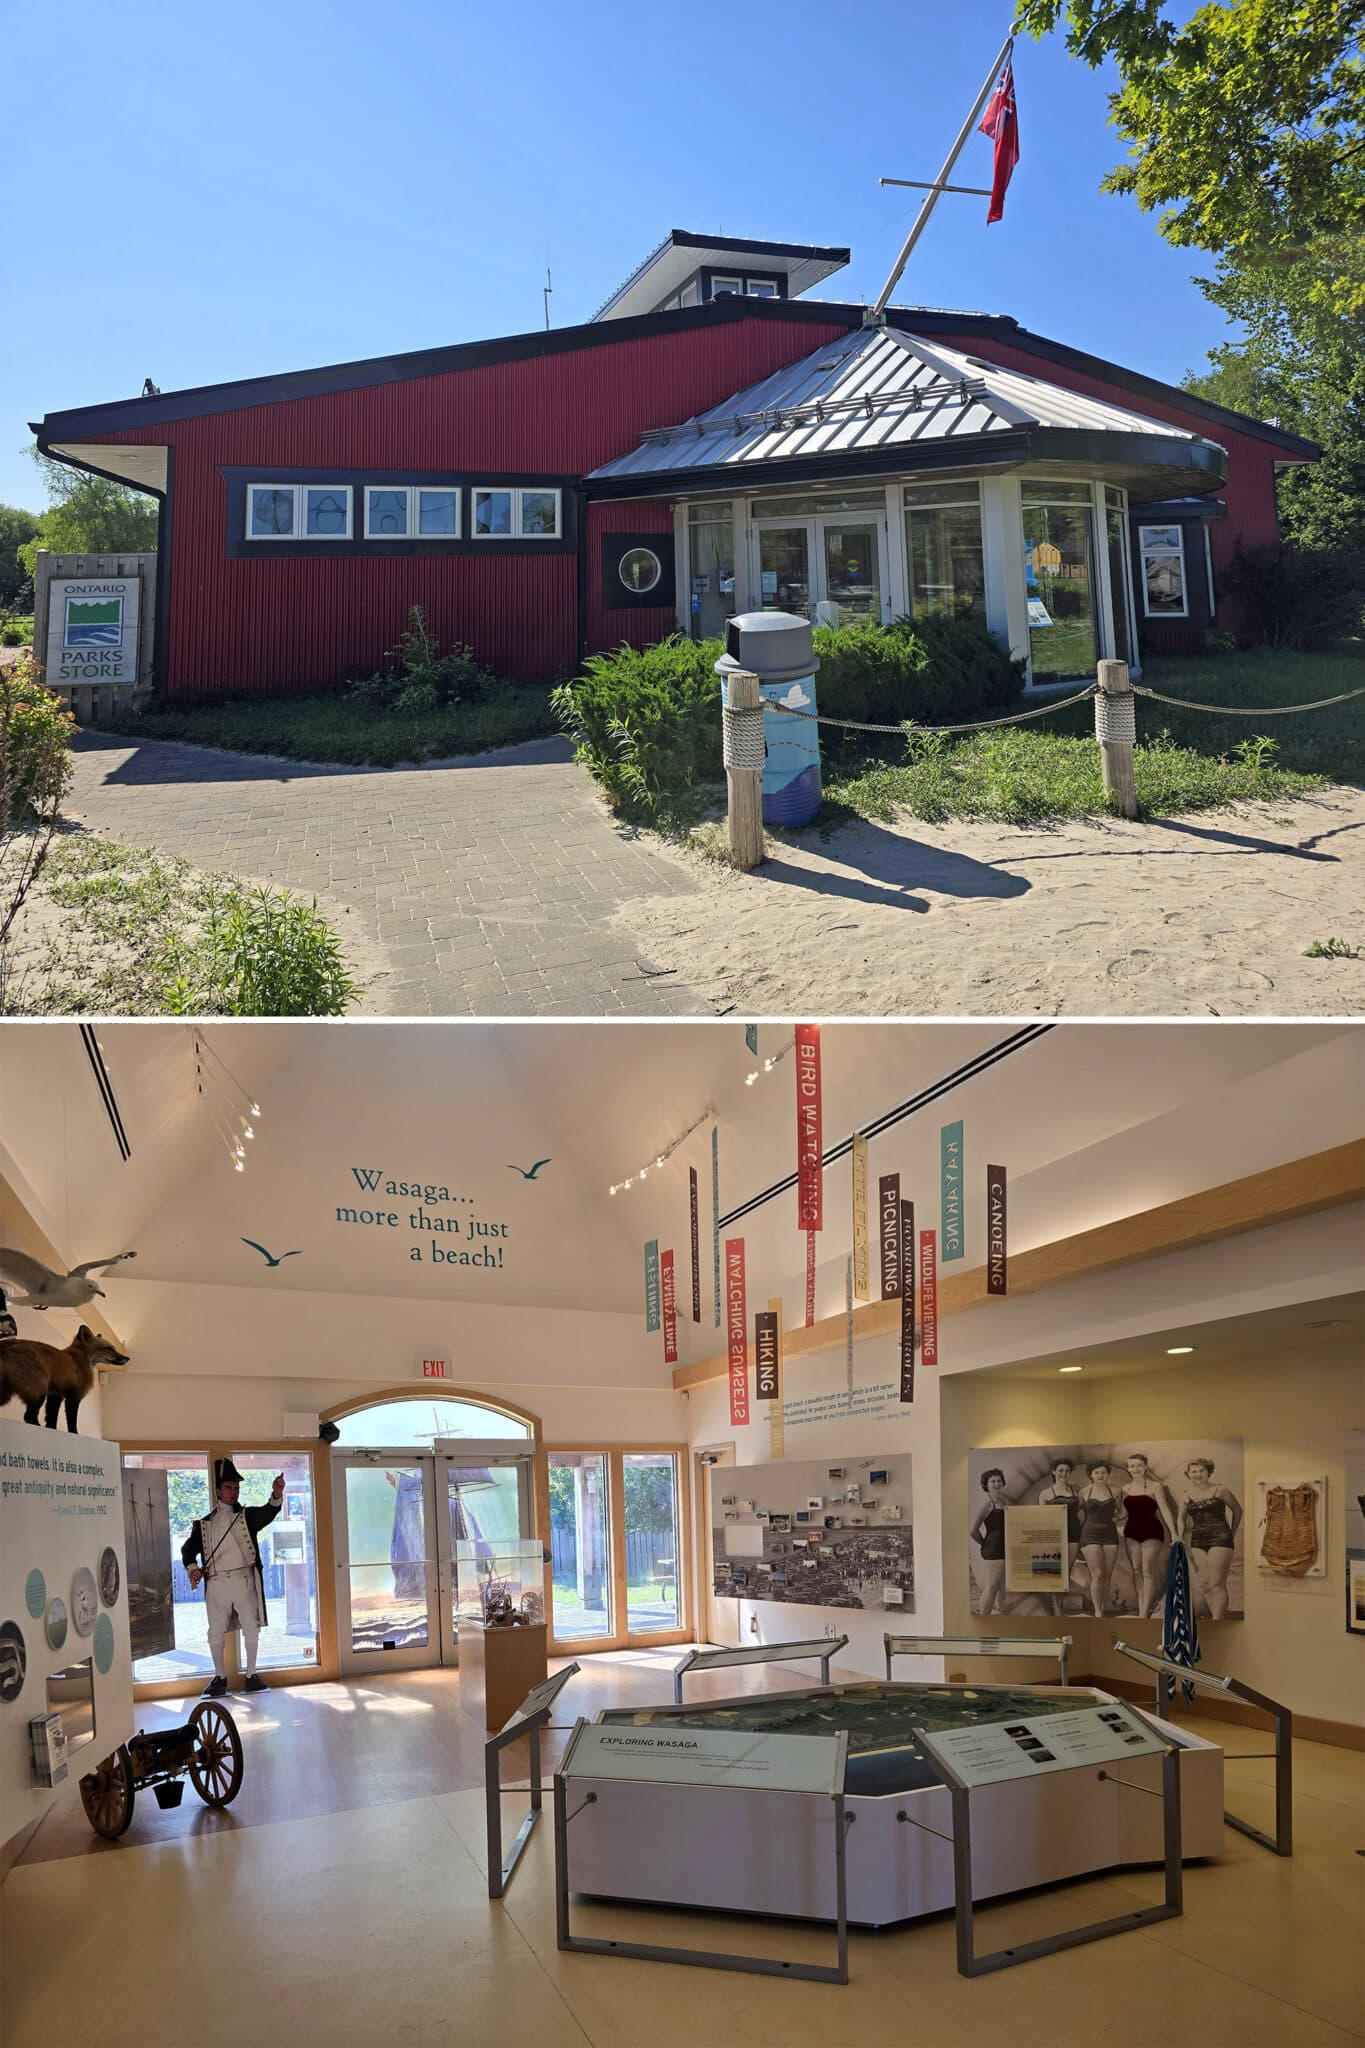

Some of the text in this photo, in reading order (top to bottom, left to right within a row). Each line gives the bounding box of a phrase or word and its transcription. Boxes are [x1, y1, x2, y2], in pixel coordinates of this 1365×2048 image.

[64, 584, 127, 593] ONTARIO
[59, 664, 123, 679] STORE
[61, 650, 123, 664] PARKS
[799, 1044, 817, 1097] BIRD
[801, 1103, 818, 1221] WATCHING
[351, 1167, 475, 1206] Wasaga...
[335, 1206, 509, 1240] more than just
[855, 1153, 868, 1292] KITE FLYING
[990, 1182, 1004, 1286] CANOEING
[409, 1239, 504, 1269] a beach!
[881, 1189, 901, 1293] PICNICKING
[902, 1216, 914, 1318] BOARDWALK
[921, 1244, 935, 1357] WILDLIFE VIEWING
[423, 1360, 447, 1377] EXIT
[759, 1328, 775, 1392] HIKING
[8, 1452, 26, 1468] bath
[27, 1454, 51, 1471] towels.
[52, 1457, 58, 1471] It
[59, 1459, 65, 1472] is
[65, 1460, 78, 1474] also
[78, 1466, 82, 1474] a
[2, 1480, 23, 1497] great
[24, 1480, 55, 1498] antiquity
[55, 1481, 67, 1495] and
[67, 1483, 87, 1496] natural
[599, 1736, 699, 1749] EXPLORING WASAGA
